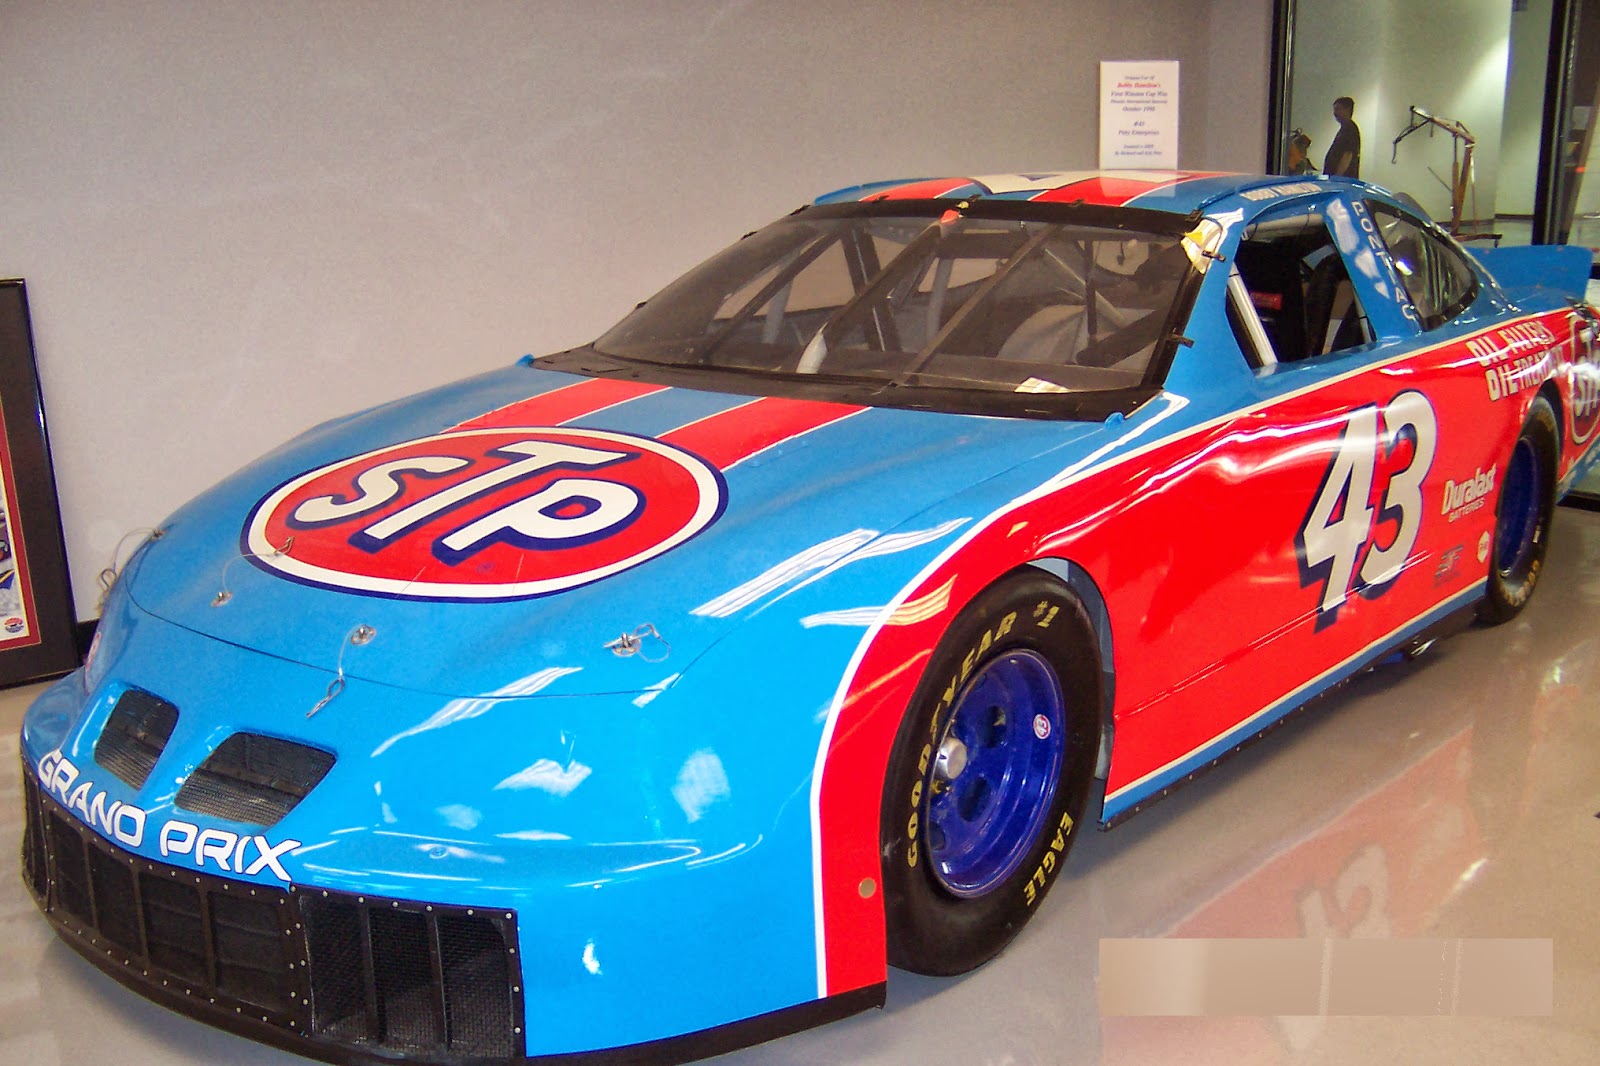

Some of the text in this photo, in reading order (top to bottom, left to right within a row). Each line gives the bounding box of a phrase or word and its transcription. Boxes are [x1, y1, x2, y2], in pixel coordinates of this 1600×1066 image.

[1351, 200, 1417, 321] PONTIAC
[1465, 335, 1508, 367] OIL
[1485, 363, 1519, 401] OIL
[288, 439, 643, 564] STP
[1296, 388, 1438, 628] 43
[907, 599, 1061, 869] GOODYEAR #1
[37, 748, 302, 882] GRAND PRIX
[1023, 811, 1075, 907] EAGLE
